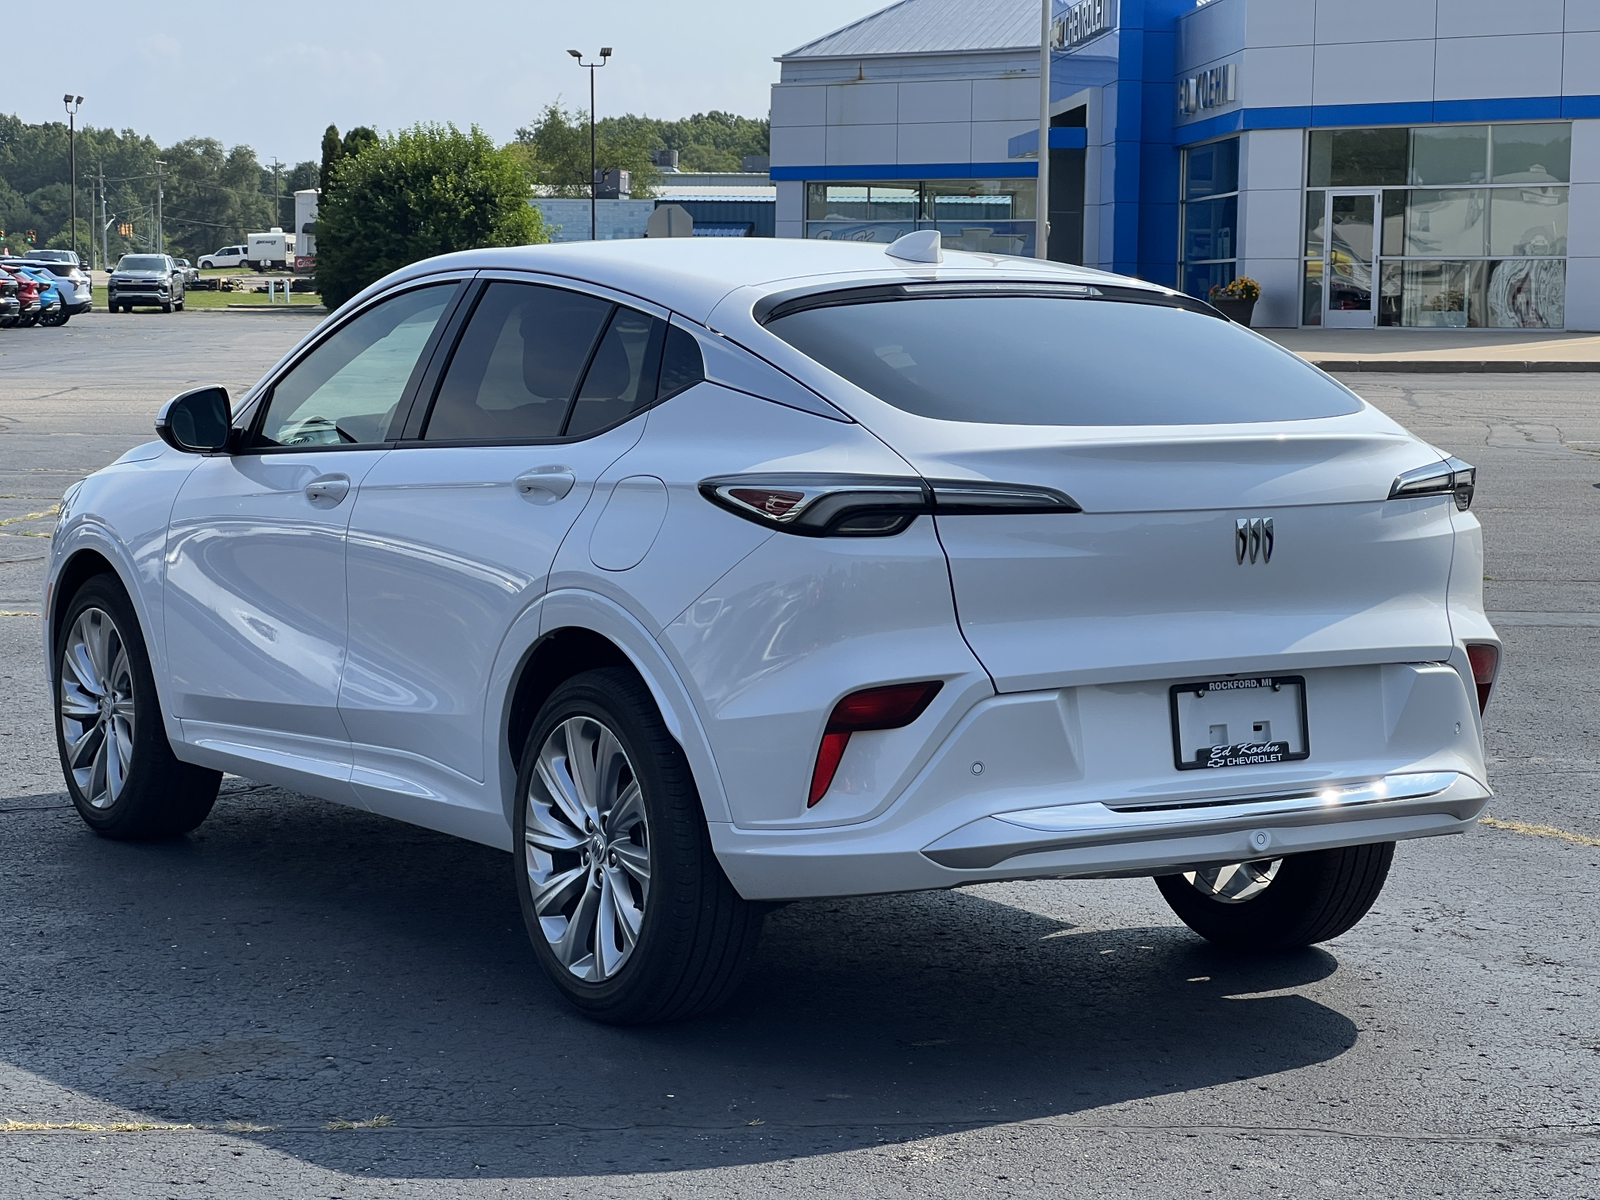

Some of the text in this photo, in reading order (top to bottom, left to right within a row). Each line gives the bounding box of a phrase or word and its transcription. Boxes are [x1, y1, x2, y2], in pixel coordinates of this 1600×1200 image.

[1064, 0, 1104, 46] CHEVROLET
[1209, 678, 1272, 690] ROCKFORD, MI
[1210, 741, 1280, 758] Ed Koehn
[1227, 753, 1283, 765] CHEVROLET
